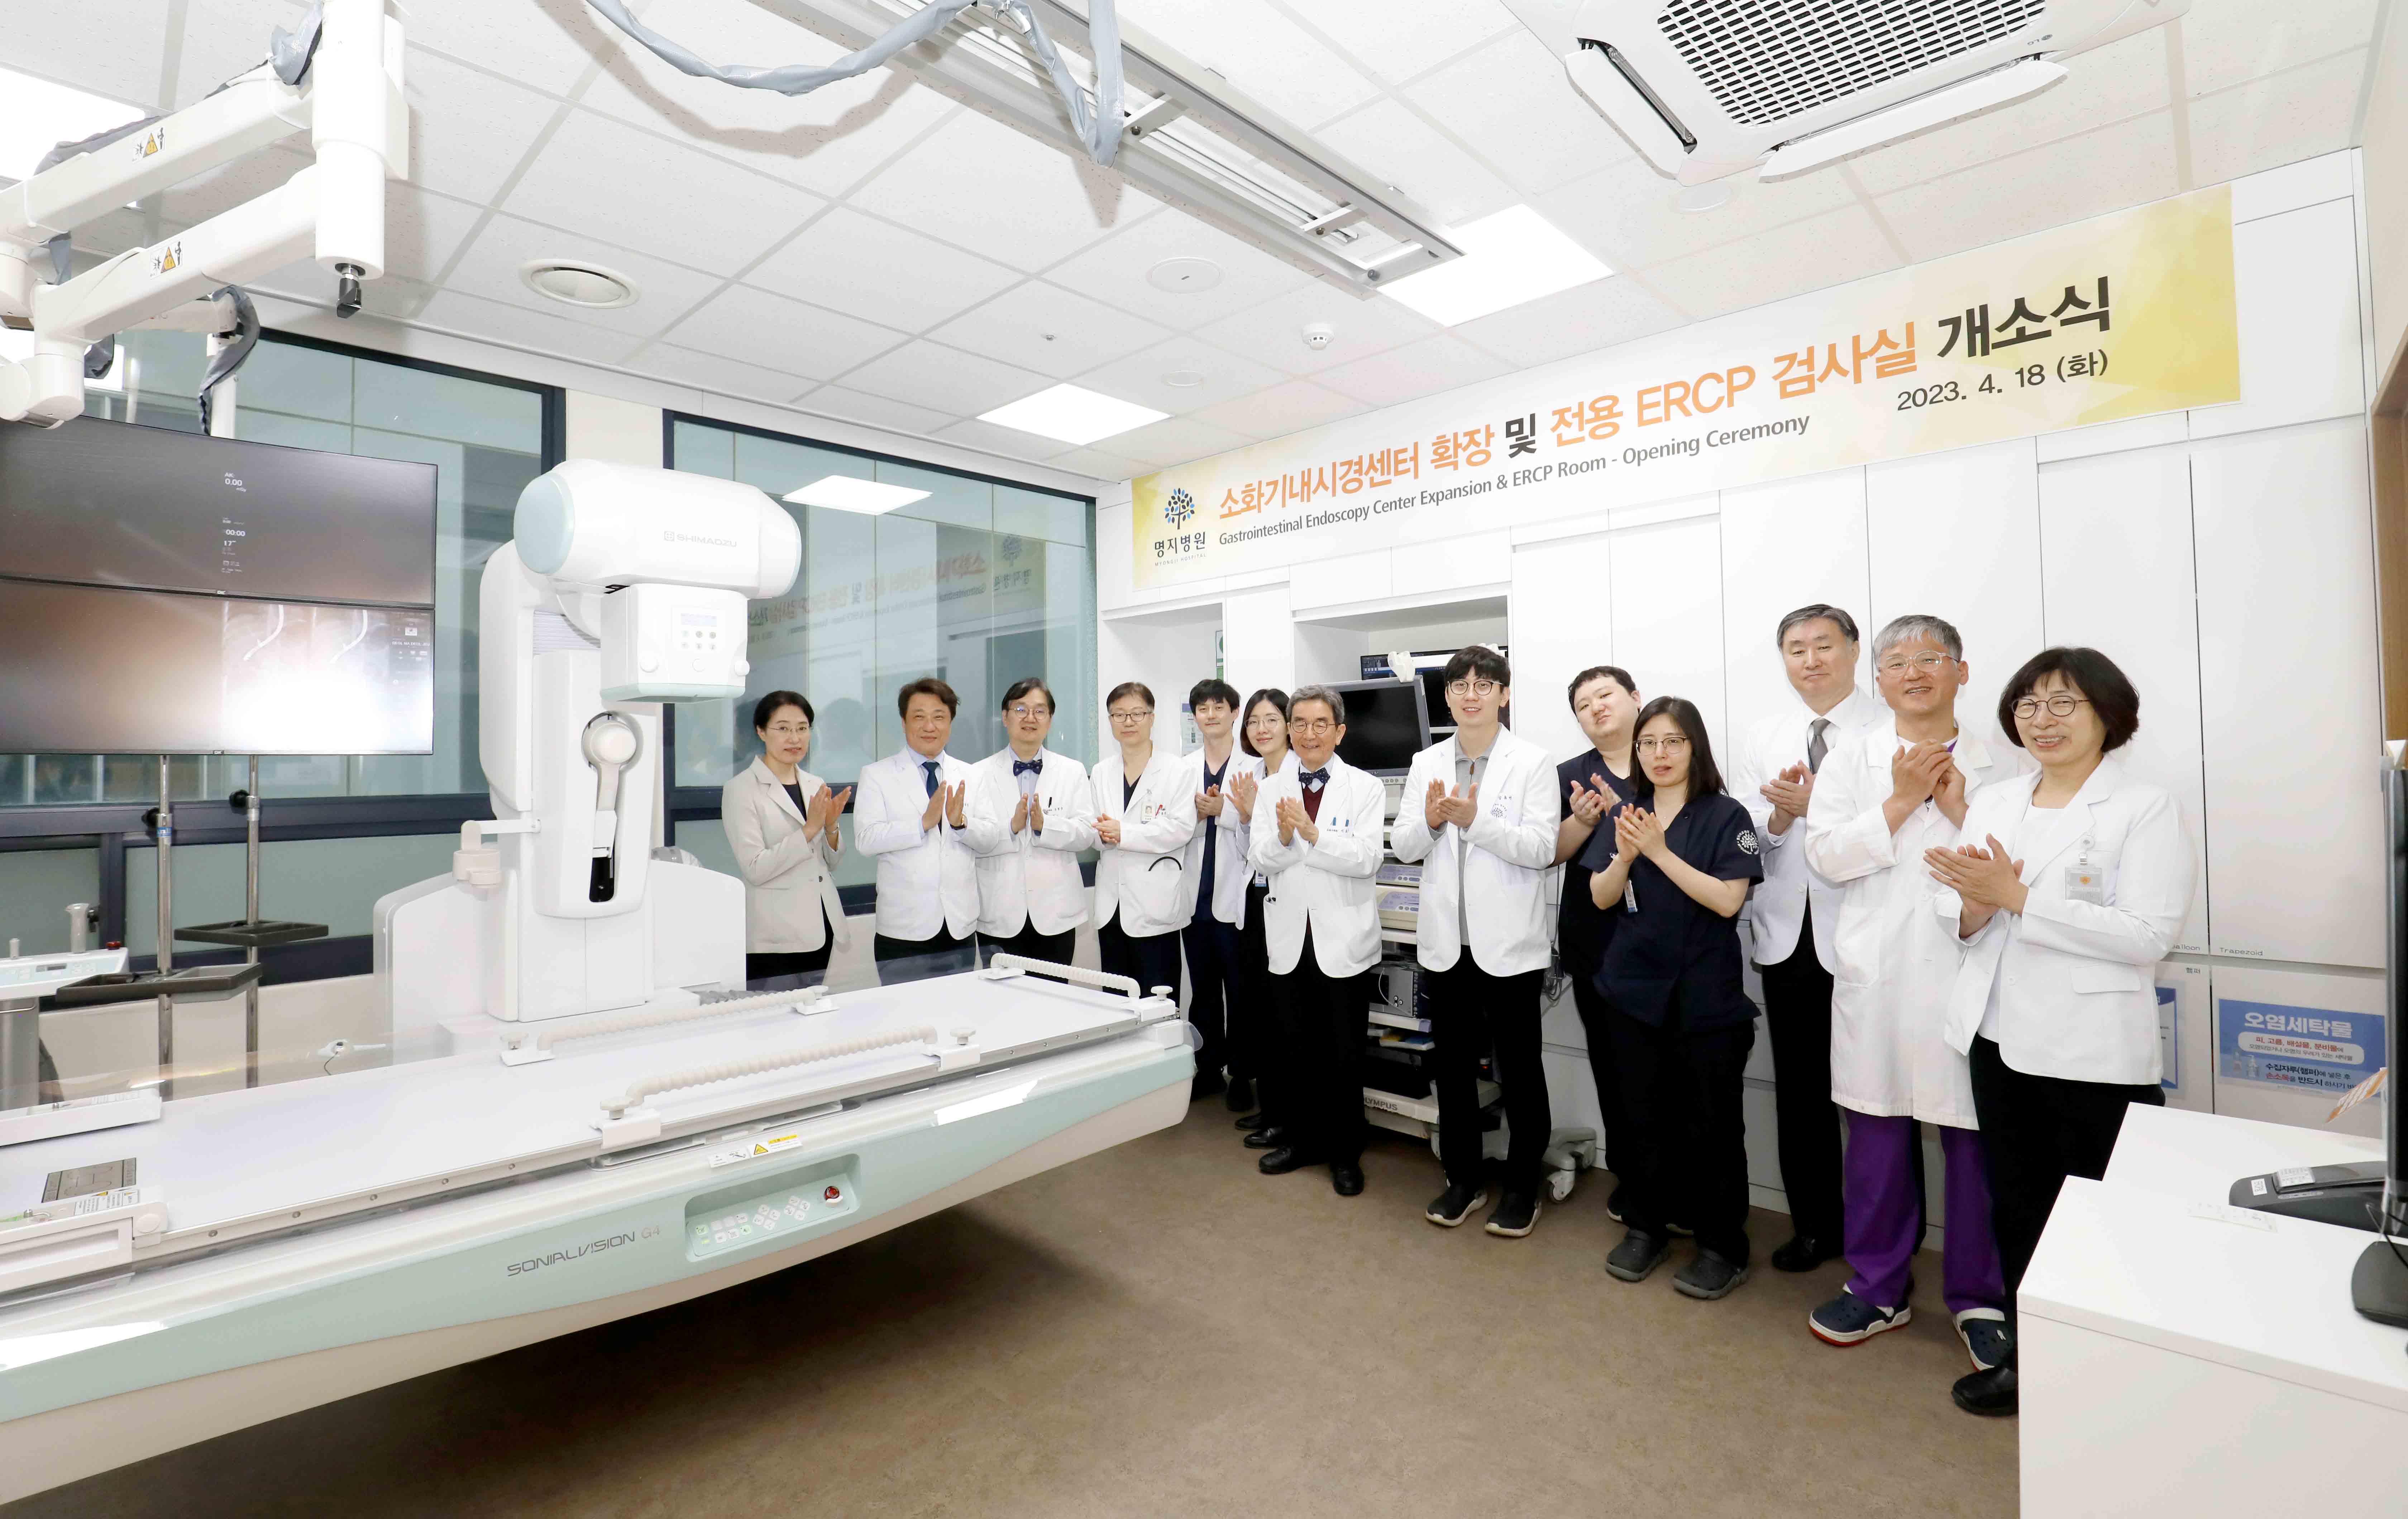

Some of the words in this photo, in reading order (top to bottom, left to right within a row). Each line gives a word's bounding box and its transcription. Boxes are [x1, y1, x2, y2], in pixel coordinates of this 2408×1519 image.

[1897, 381, 1967, 411] 2023.
[1978, 373, 2003, 394] 4.
[2015, 364, 2045, 388] 18
[2056, 349, 2108, 383] (화)
[1219, 441, 1419, 519] 소화기내시경센터
[1430, 423, 1495, 471] 확장
[1505, 413, 1537, 459] 및
[1550, 395, 1623, 447] 전용
[1637, 365, 1756, 427] ERCP
[1772, 321, 1917, 400] 검사실
[1936, 275, 2111, 358] 개소식
[225, 478, 243, 486] 0.00
[1219, 515, 1303, 545] Gastrointestinal
[1306, 504, 1370, 529] Endoscopy
[1373, 494, 1416, 514] Center
[1420, 480, 1492, 507] Expansion
[1496, 474, 1508, 490] &
[1513, 465, 1553, 487] ERCP
[1558, 456, 1606, 478] Room
[1623, 437, 1700, 466] Opening
[1706, 415, 1810, 448] Ceremony
[676, 533, 737, 547] SHIMADZU
[1154, 531, 1205, 558] 명지병원
[1181, 553, 1206, 562] HOSPITAL
[2220, 947, 2264, 956] Trapezoid
[2244, 1012, 2353, 1039] 오염세탁물
[2298, 1076, 2322, 1086] 반드시
[1364, 1097, 1398, 1111] LYMPUS
[507, 1231, 635, 1277] SONIALVISION
[641, 1225, 660, 1239] G4
